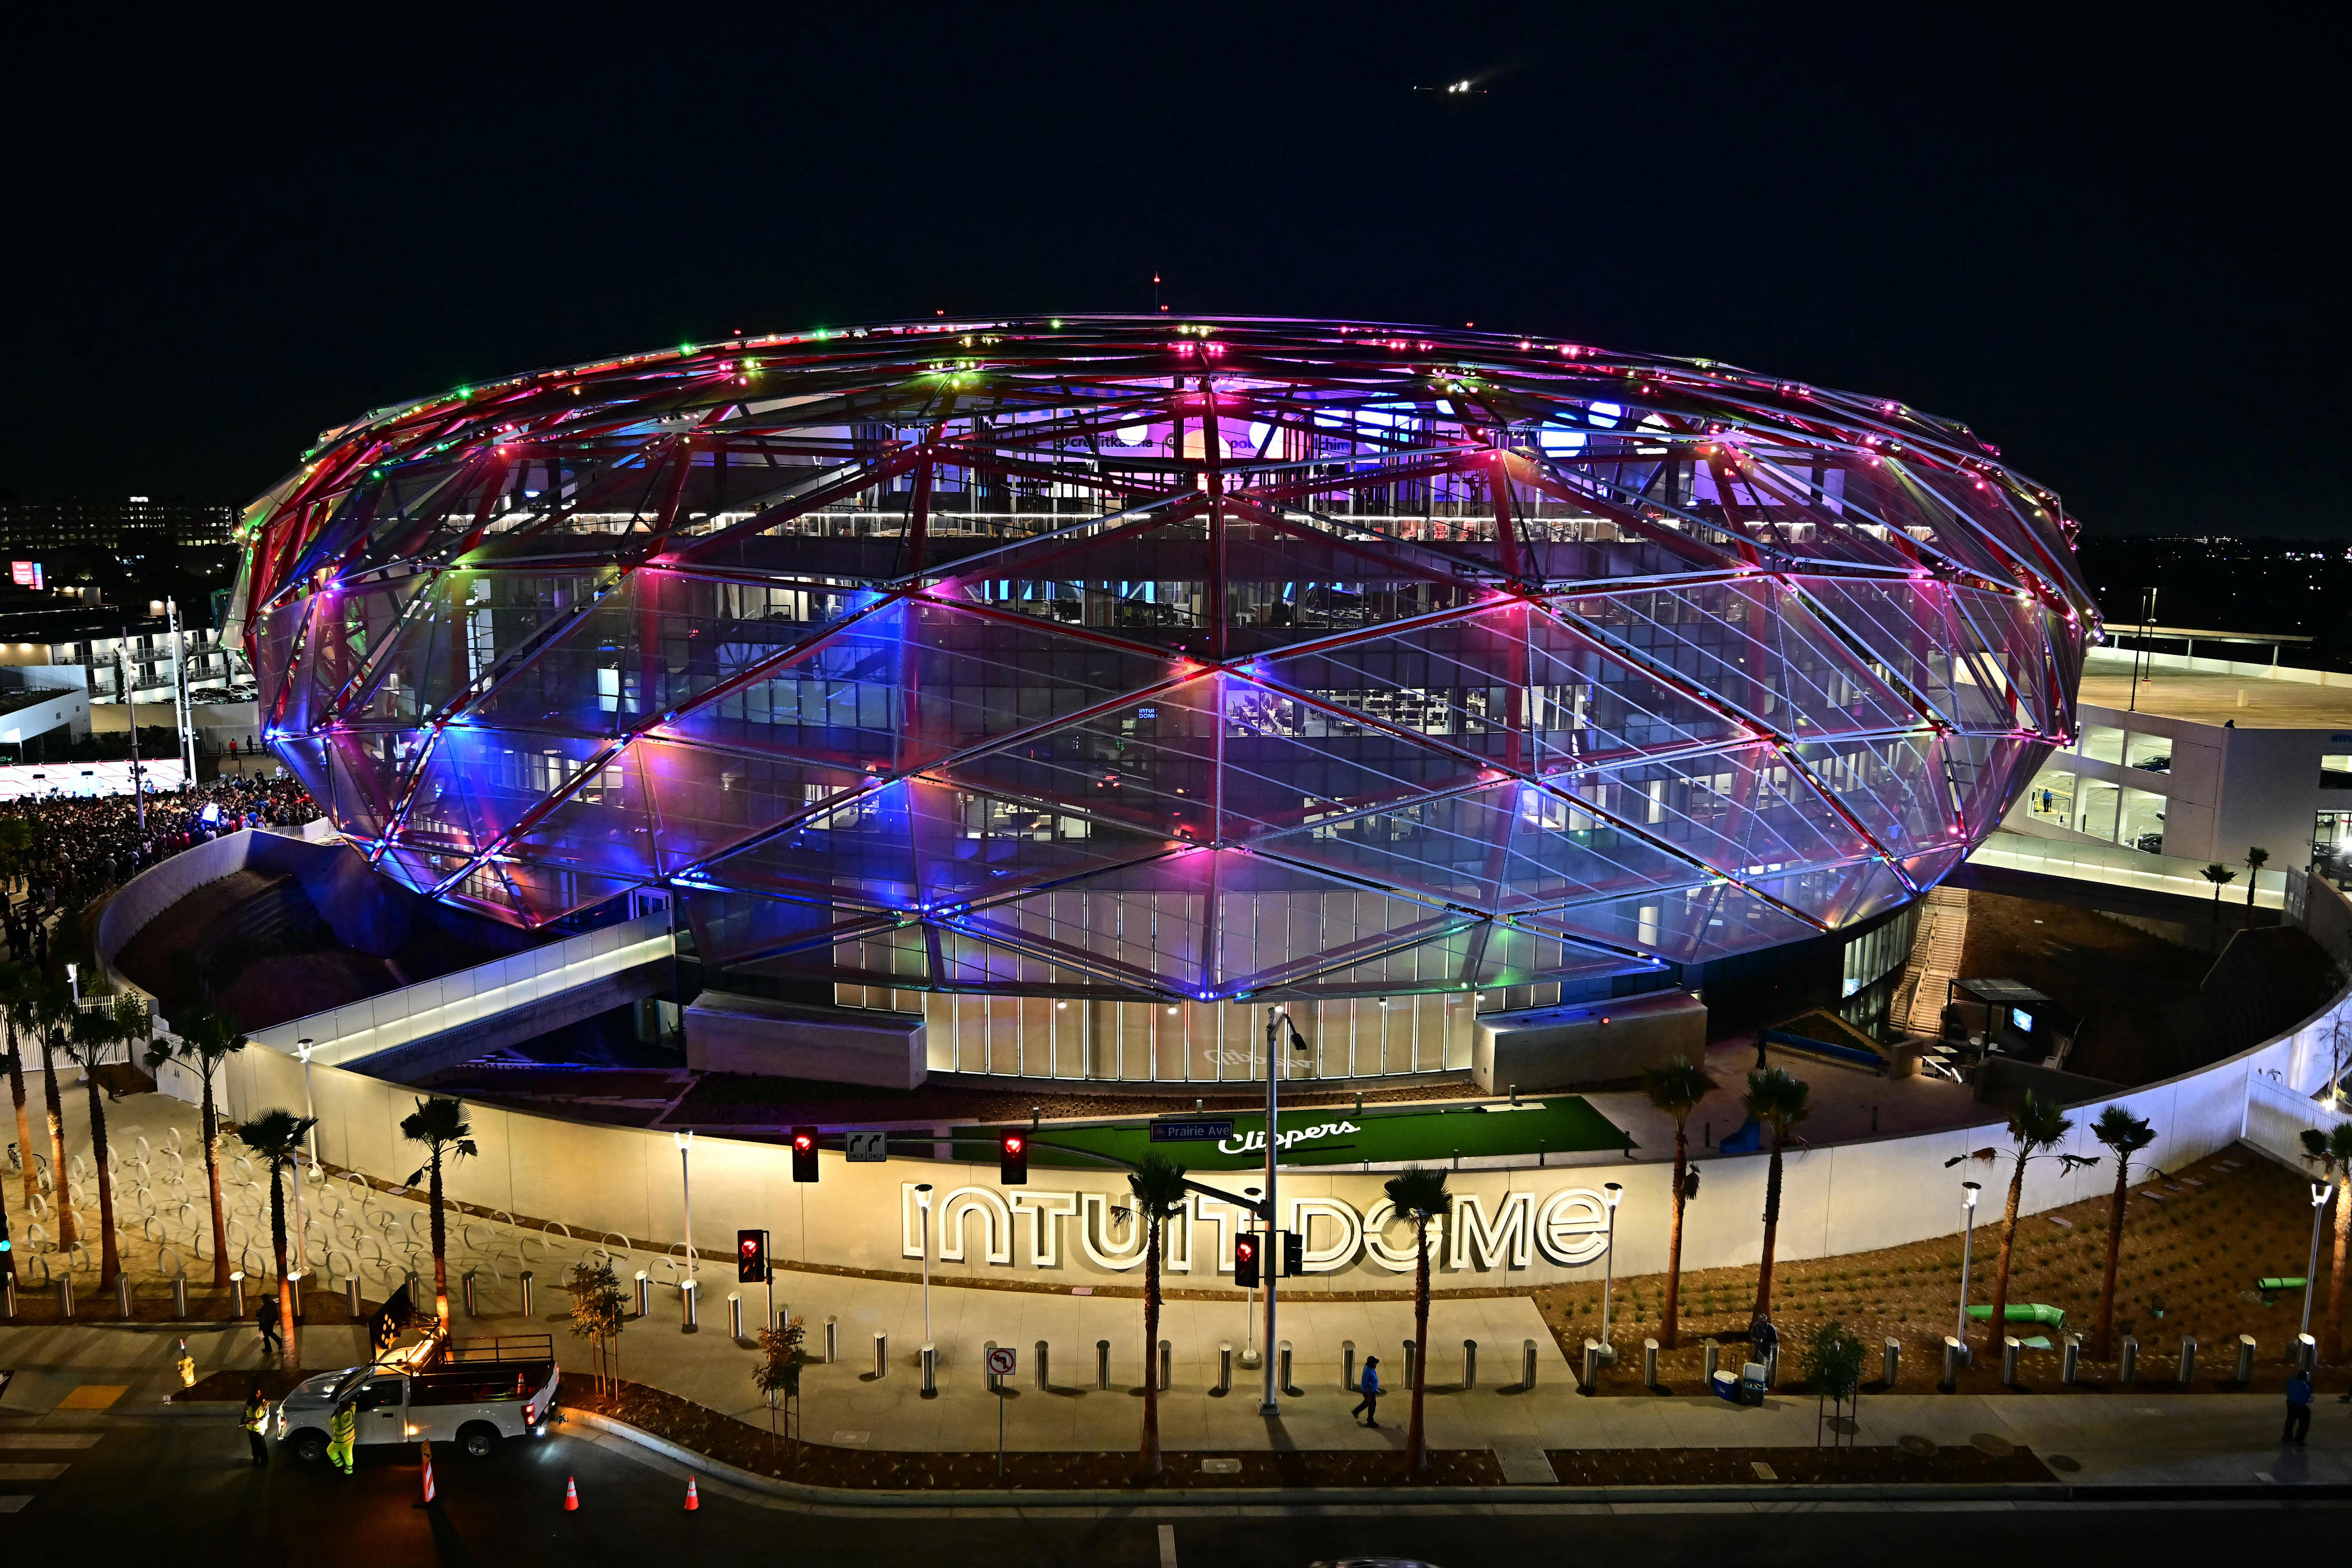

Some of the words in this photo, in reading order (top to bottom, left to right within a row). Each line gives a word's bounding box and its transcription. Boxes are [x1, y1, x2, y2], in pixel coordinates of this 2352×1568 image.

[1071, 434, 1153, 447] creitkaa
[1168, 1126, 1205, 1136] Prairie
[1208, 1126, 1230, 1136] Ave
[1218, 1121, 1361, 1154] Clippers
